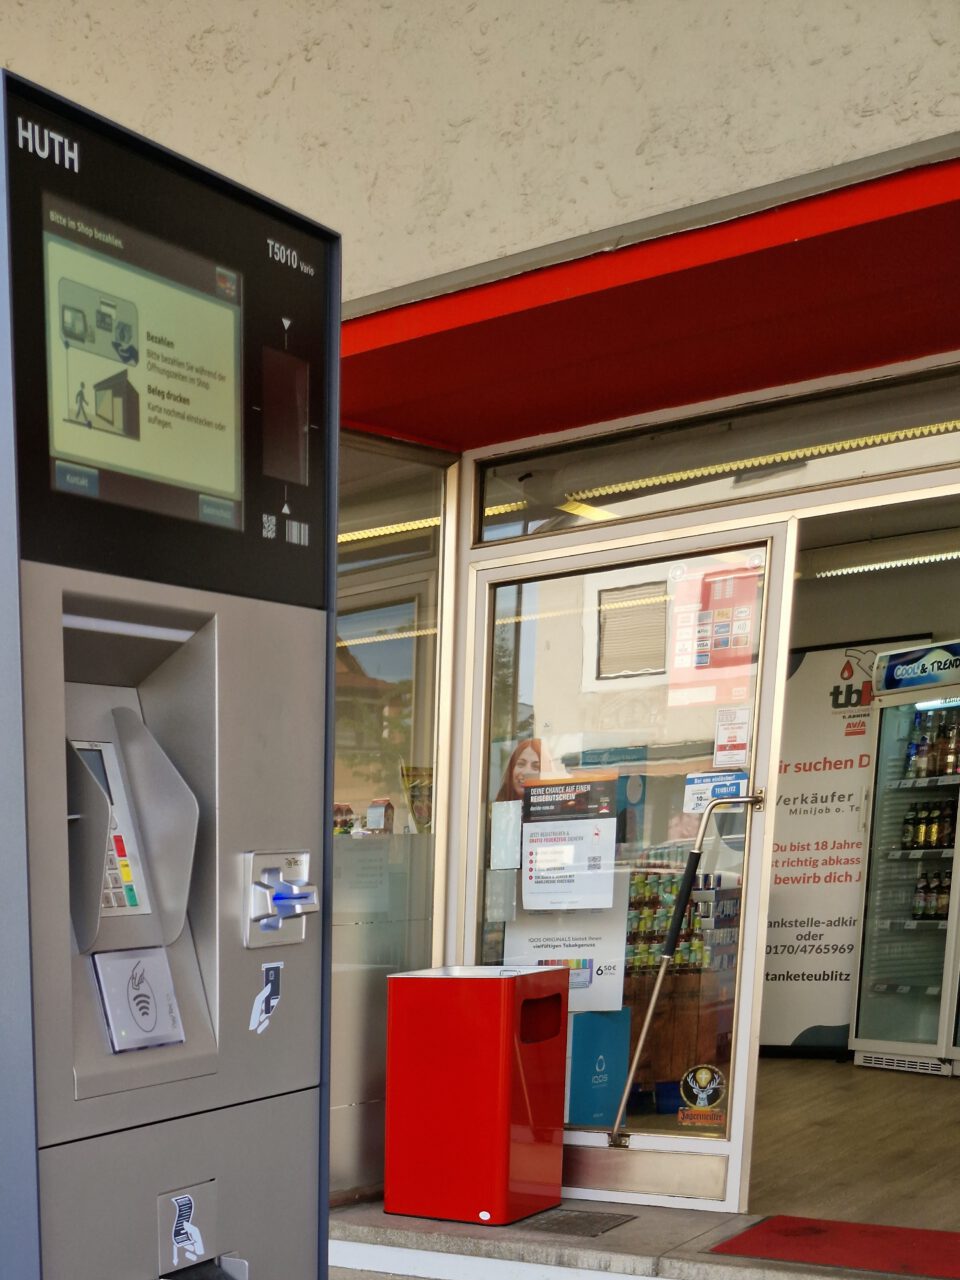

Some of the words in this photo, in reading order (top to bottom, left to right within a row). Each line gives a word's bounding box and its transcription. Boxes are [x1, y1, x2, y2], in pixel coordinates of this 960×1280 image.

[18, 116, 79, 173] HUTH
[49, 210, 67, 227] Bitte
[67, 217, 76, 231] im
[77, 221, 93, 238] Shop
[267, 239, 298, 269] T5010
[300, 261, 315, 277] Vario
[147, 331, 174, 349] Bezahlen
[147, 384, 165, 400] Beleg
[166, 390, 190, 406] drucken
[894, 664, 918, 678] COOL
[794, 757, 854, 773] suchen
[530, 787, 545, 796] DEINE
[546, 786, 564, 794] CHANCE
[789, 807, 830, 816] Minijob
[790, 841, 810, 852] bist
[814, 841, 828, 851] 18
[831, 840, 863, 850] Jahre
[781, 857, 819, 868] richtig
[774, 873, 820, 885] bewirb
[824, 872, 853, 883] dich
[796, 931, 824, 941] oder
